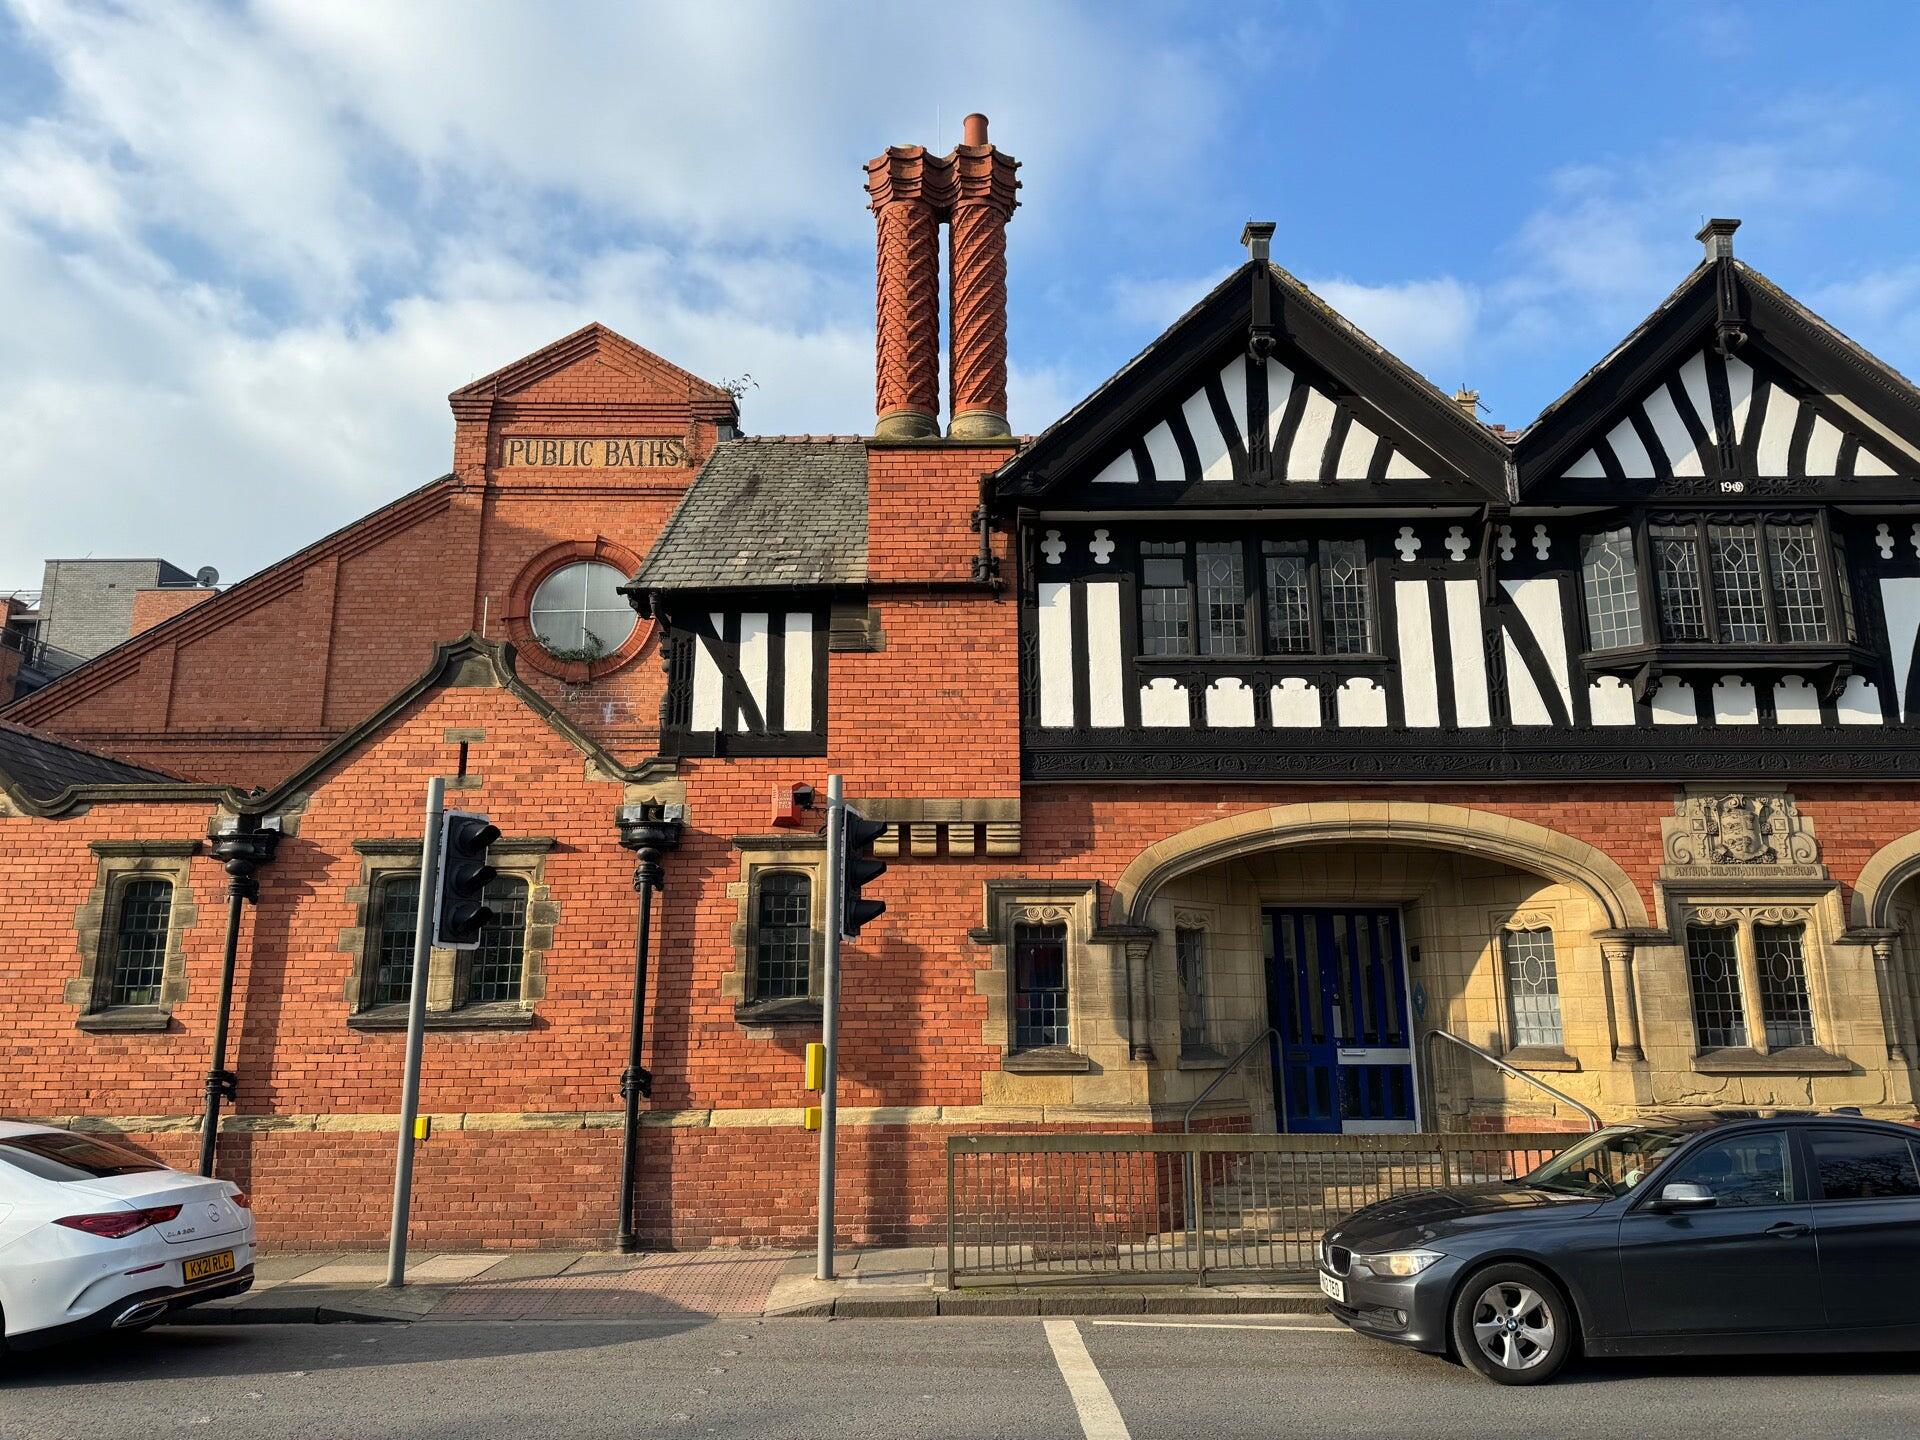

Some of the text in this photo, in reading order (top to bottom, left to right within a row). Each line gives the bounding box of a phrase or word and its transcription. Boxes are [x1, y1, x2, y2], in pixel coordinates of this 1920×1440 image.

[508, 440, 680, 466] PUBLIC BATHS
[190, 1255, 230, 1277] KX21 RLG
